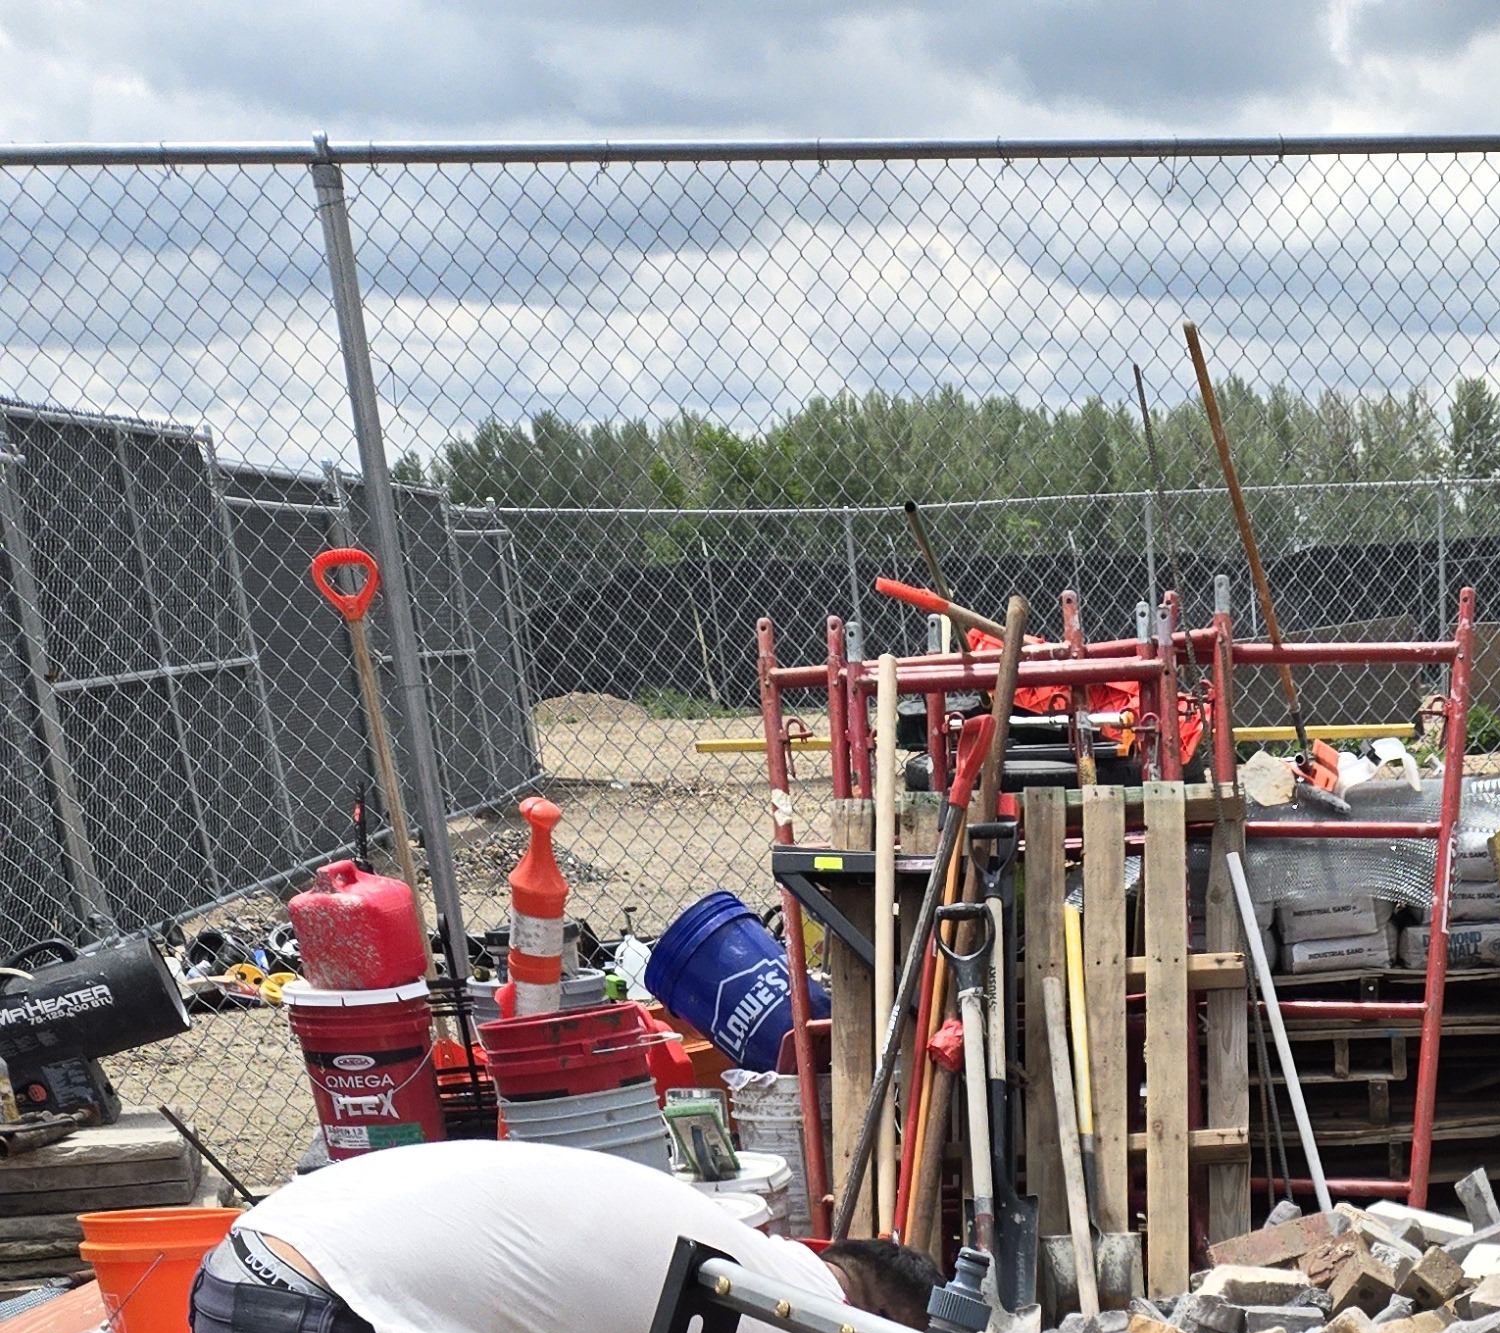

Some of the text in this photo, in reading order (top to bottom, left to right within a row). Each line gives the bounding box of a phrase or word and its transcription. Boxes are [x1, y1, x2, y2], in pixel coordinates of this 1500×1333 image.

[1332, 905, 1352, 914] SAND
[1308, 947, 1364, 960] INDUSTRIAL SAND
[25, 984, 112, 1018] HEATER
[718, 970, 788, 1053] LOWE'S
